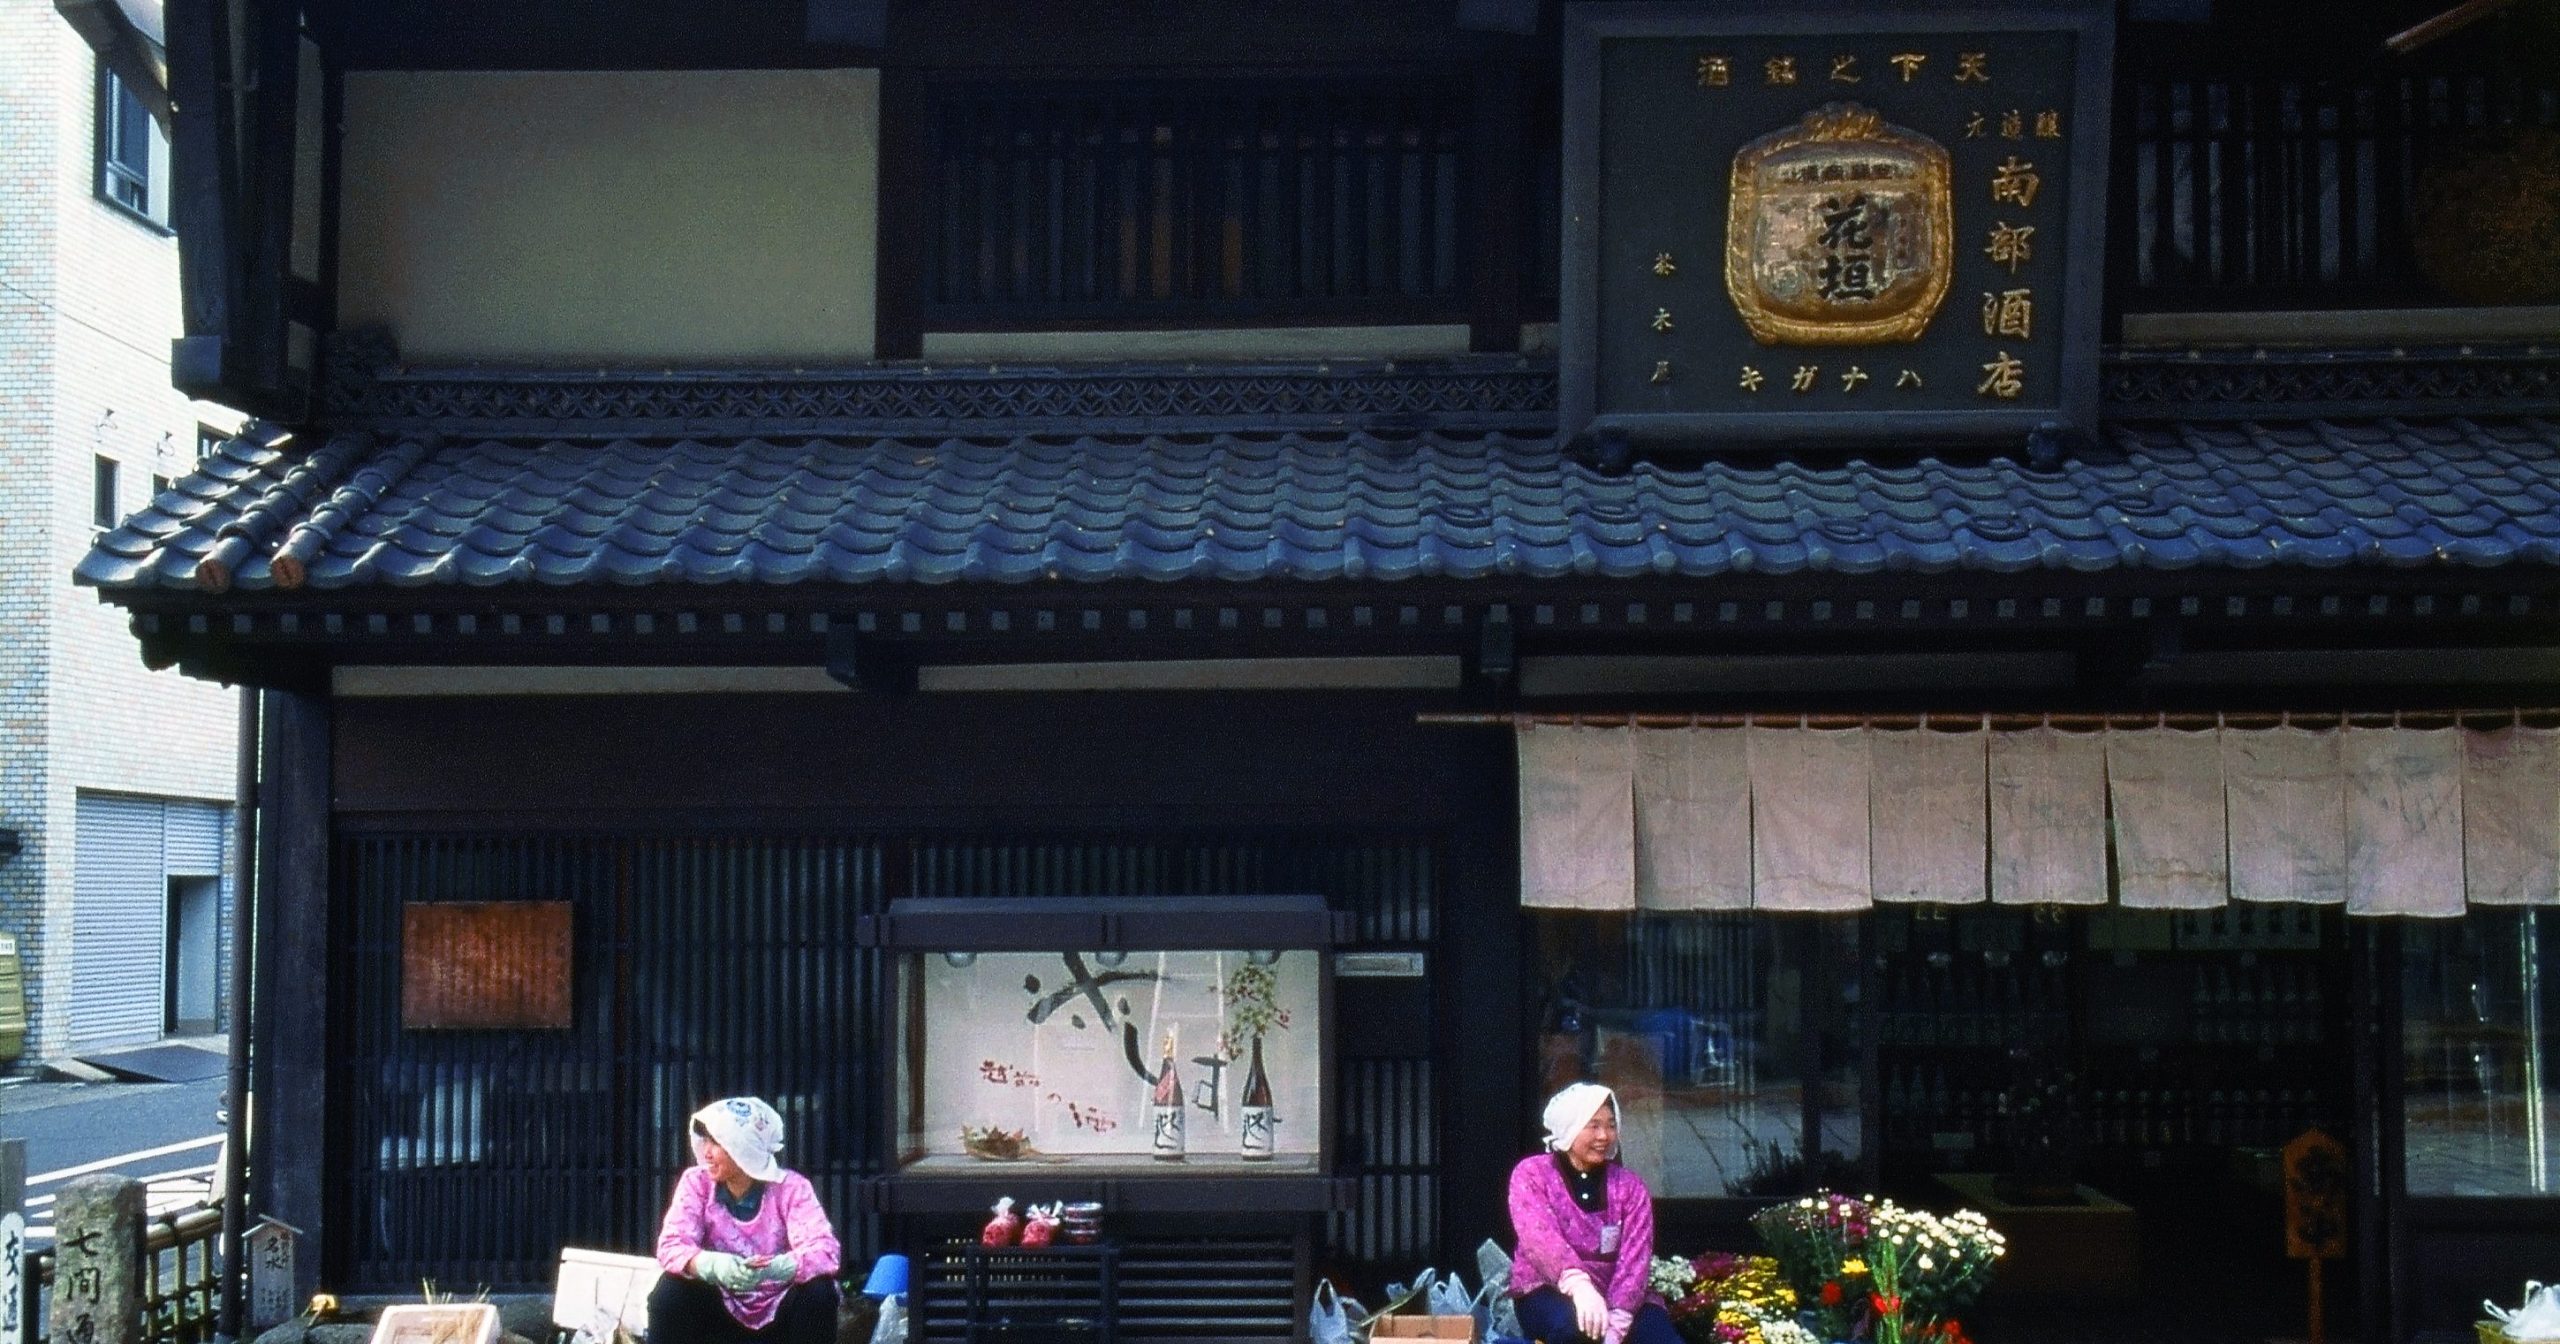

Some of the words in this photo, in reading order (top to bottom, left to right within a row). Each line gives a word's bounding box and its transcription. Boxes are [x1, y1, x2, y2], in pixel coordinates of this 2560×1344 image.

[1816, 194, 1875, 300] 花垣
[1976, 155, 2041, 398] 南部酒店
[2, 1229, 20, 1344] 交通
